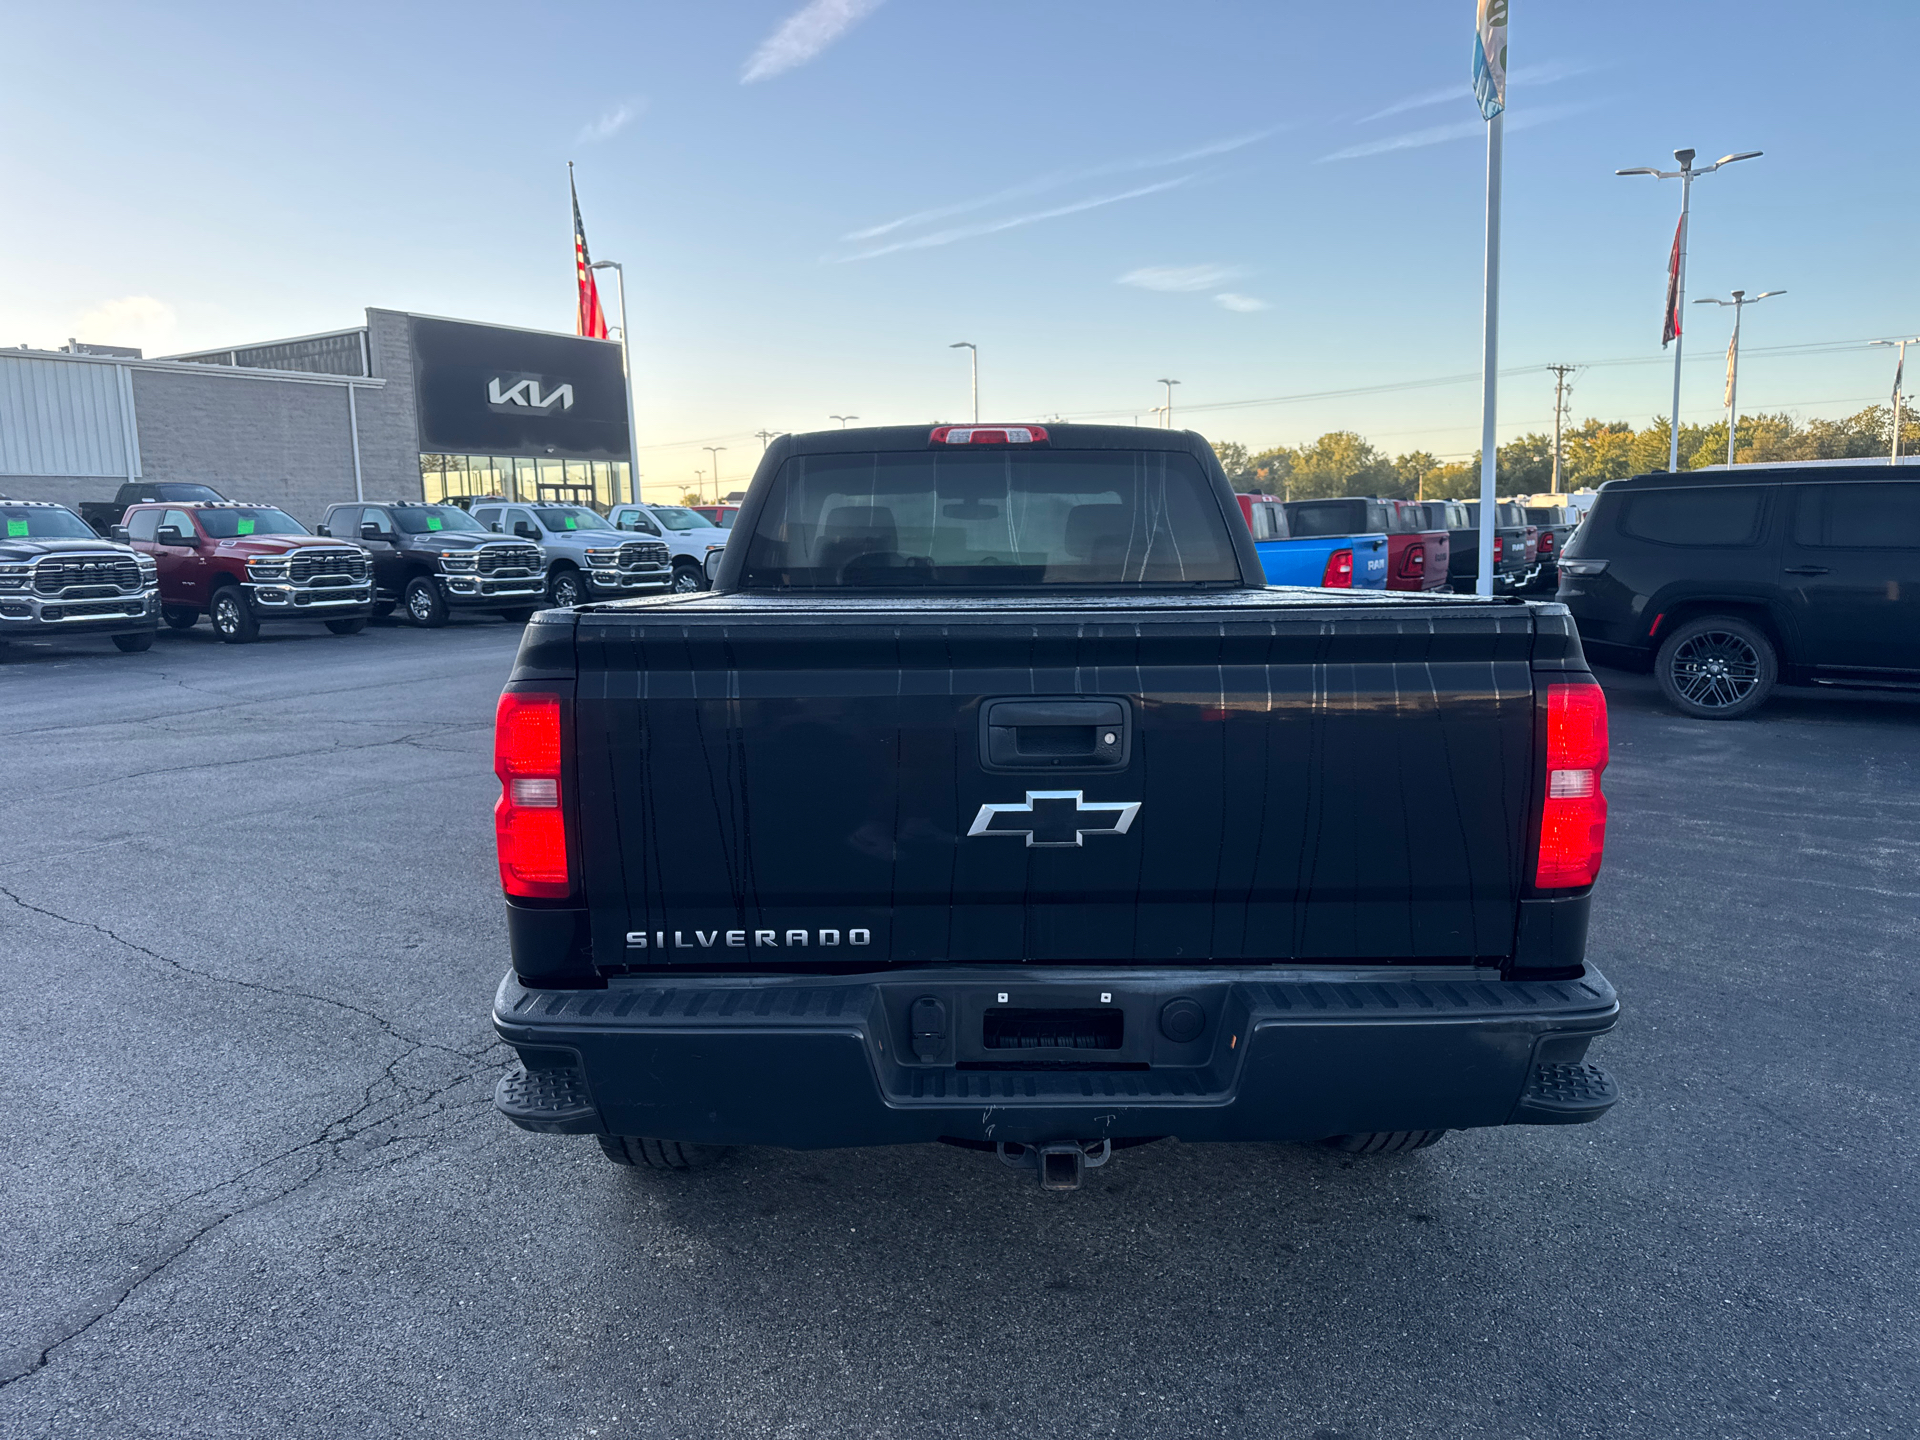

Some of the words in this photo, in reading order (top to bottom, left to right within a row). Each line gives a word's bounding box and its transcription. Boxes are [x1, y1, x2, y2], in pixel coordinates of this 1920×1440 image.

[488, 377, 574, 410] KIA
[1368, 559, 1385, 571] RAM
[626, 928, 871, 949] SILVERADO
